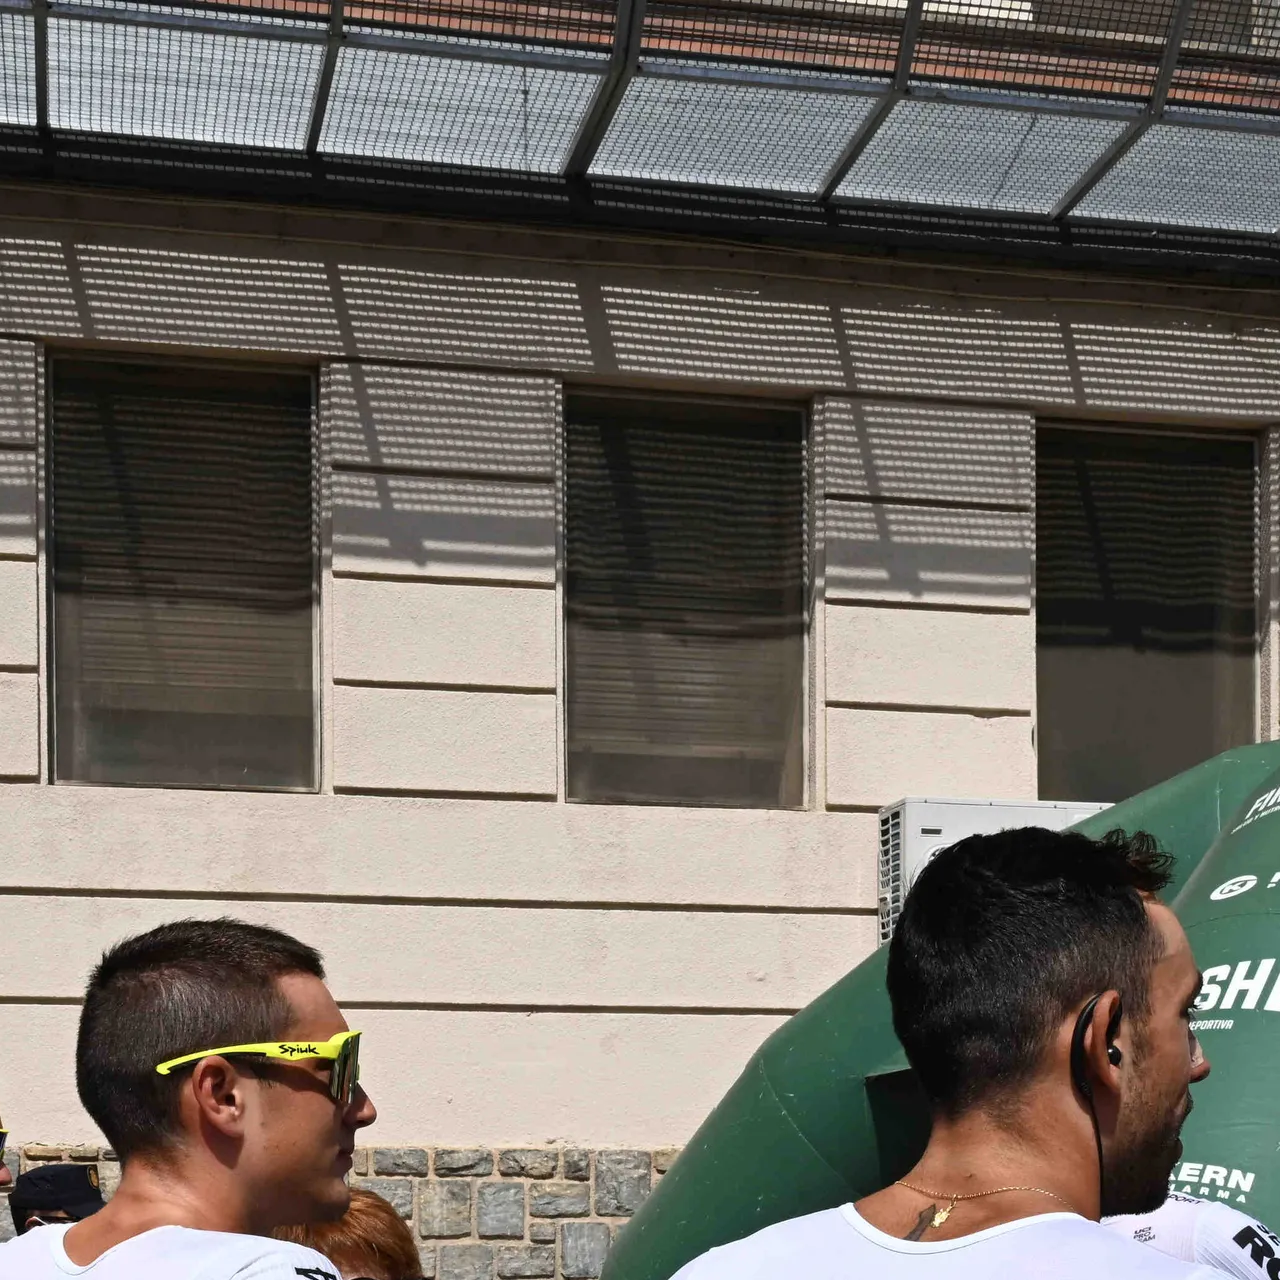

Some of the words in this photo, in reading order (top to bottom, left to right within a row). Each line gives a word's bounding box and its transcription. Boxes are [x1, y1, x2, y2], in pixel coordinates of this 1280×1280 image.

[278, 1044, 320, 1055] Spiuk
[1169, 1161, 1256, 1192] ERN
[1167, 1192, 1204, 1205] PORT
[1169, 1183, 1247, 1203] ARMA
